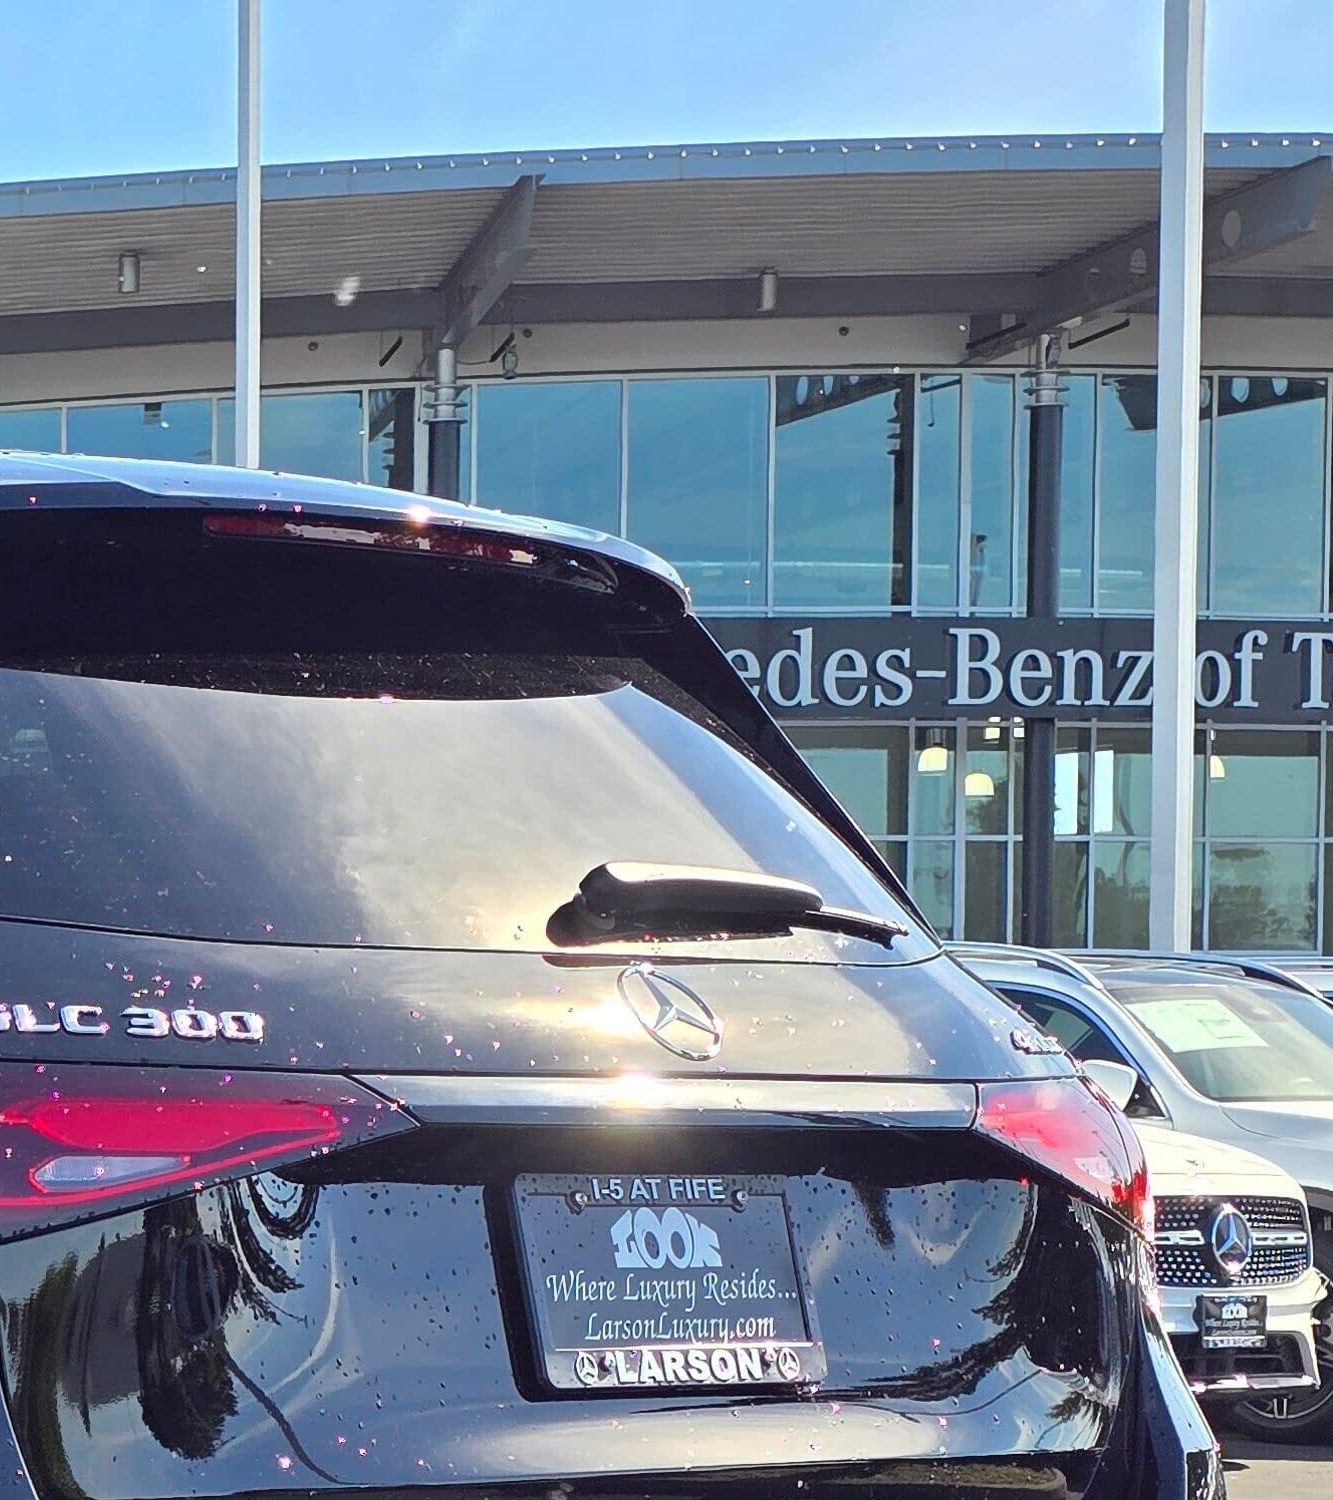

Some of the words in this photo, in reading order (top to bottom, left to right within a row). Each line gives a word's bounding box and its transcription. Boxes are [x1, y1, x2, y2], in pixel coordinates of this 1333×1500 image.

[1195, 629, 1267, 709] of
[120, 1005, 265, 1041] 300
[592, 1178, 623, 1200] I-5
[630, 1178, 661, 1200] AT
[668, 1178, 726, 1200] FIFE
[610, 1207, 724, 1269] LOOK
[546, 1270, 615, 1302] Where
[623, 1273, 697, 1312] Luxury
[703, 1268, 797, 1305] Resides...
[585, 1312, 776, 1344] LarsonLuxury.com
[614, 1349, 764, 1384] LARSON
